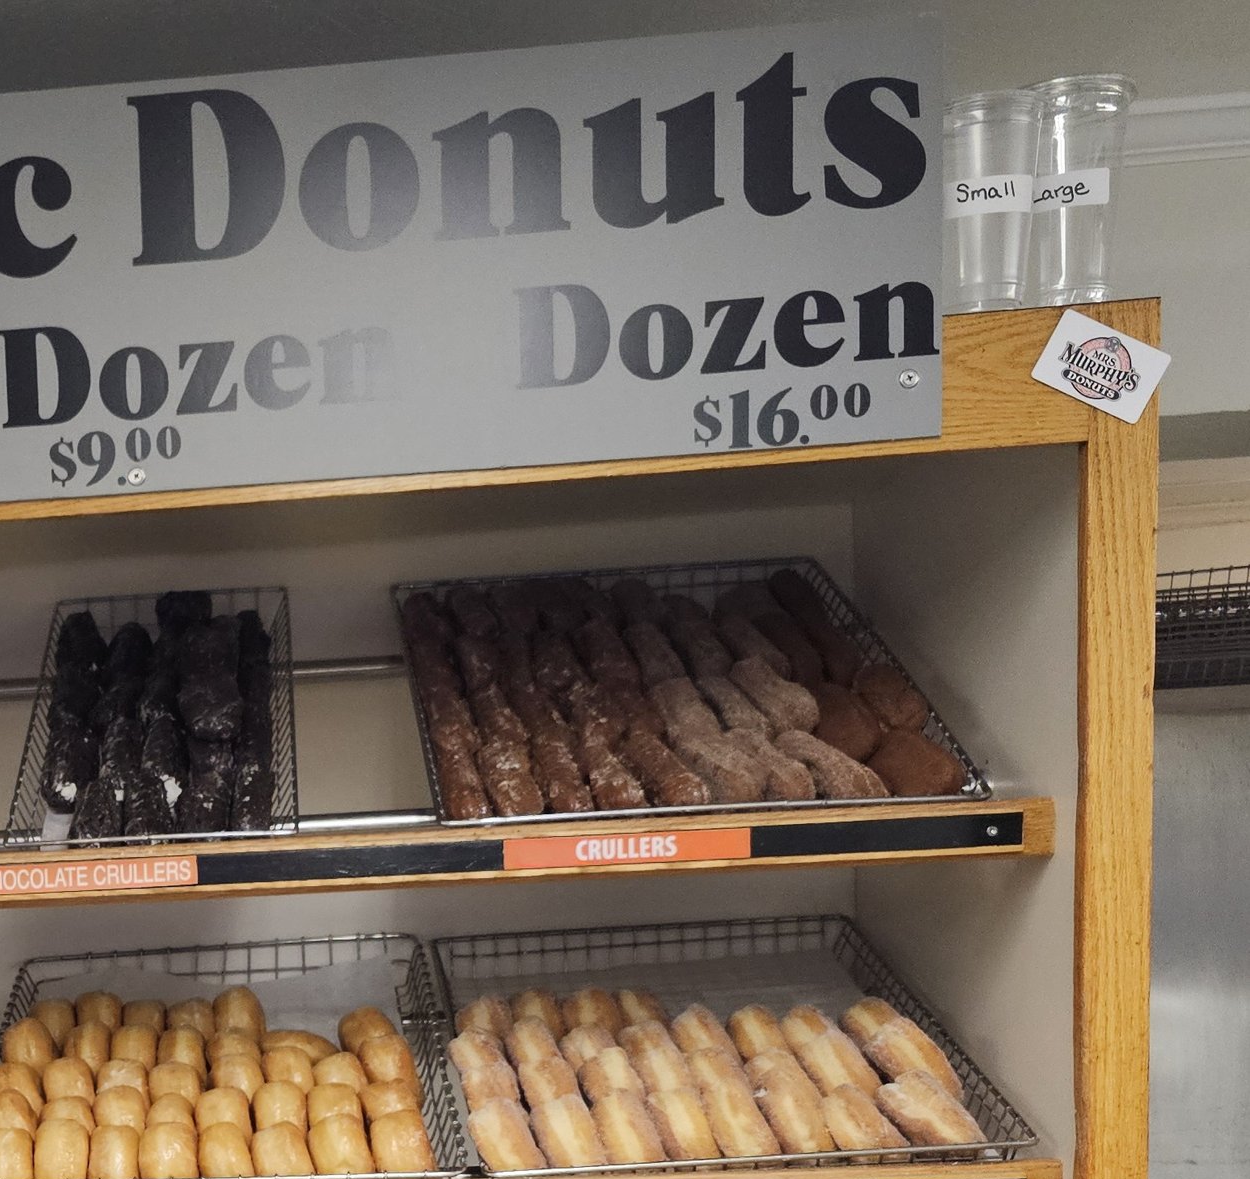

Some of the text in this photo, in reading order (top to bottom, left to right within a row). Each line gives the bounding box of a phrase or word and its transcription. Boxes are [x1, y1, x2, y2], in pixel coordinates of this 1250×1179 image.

[126, 52, 927, 266] Donuts
[956, 180, 1016, 203] Small
[513, 280, 940, 389] Dozen
[1059, 342, 1139, 391] MURPHY'S
[1091, 350, 1118, 369] MRS.
[1067, 371, 1116, 399] DONUTS
[693, 383, 872, 449] $16.00
[49, 426, 182, 488] $9.00
[575, 836, 678, 862] CRULLERS
[93, 860, 192, 886] CRULLERS
